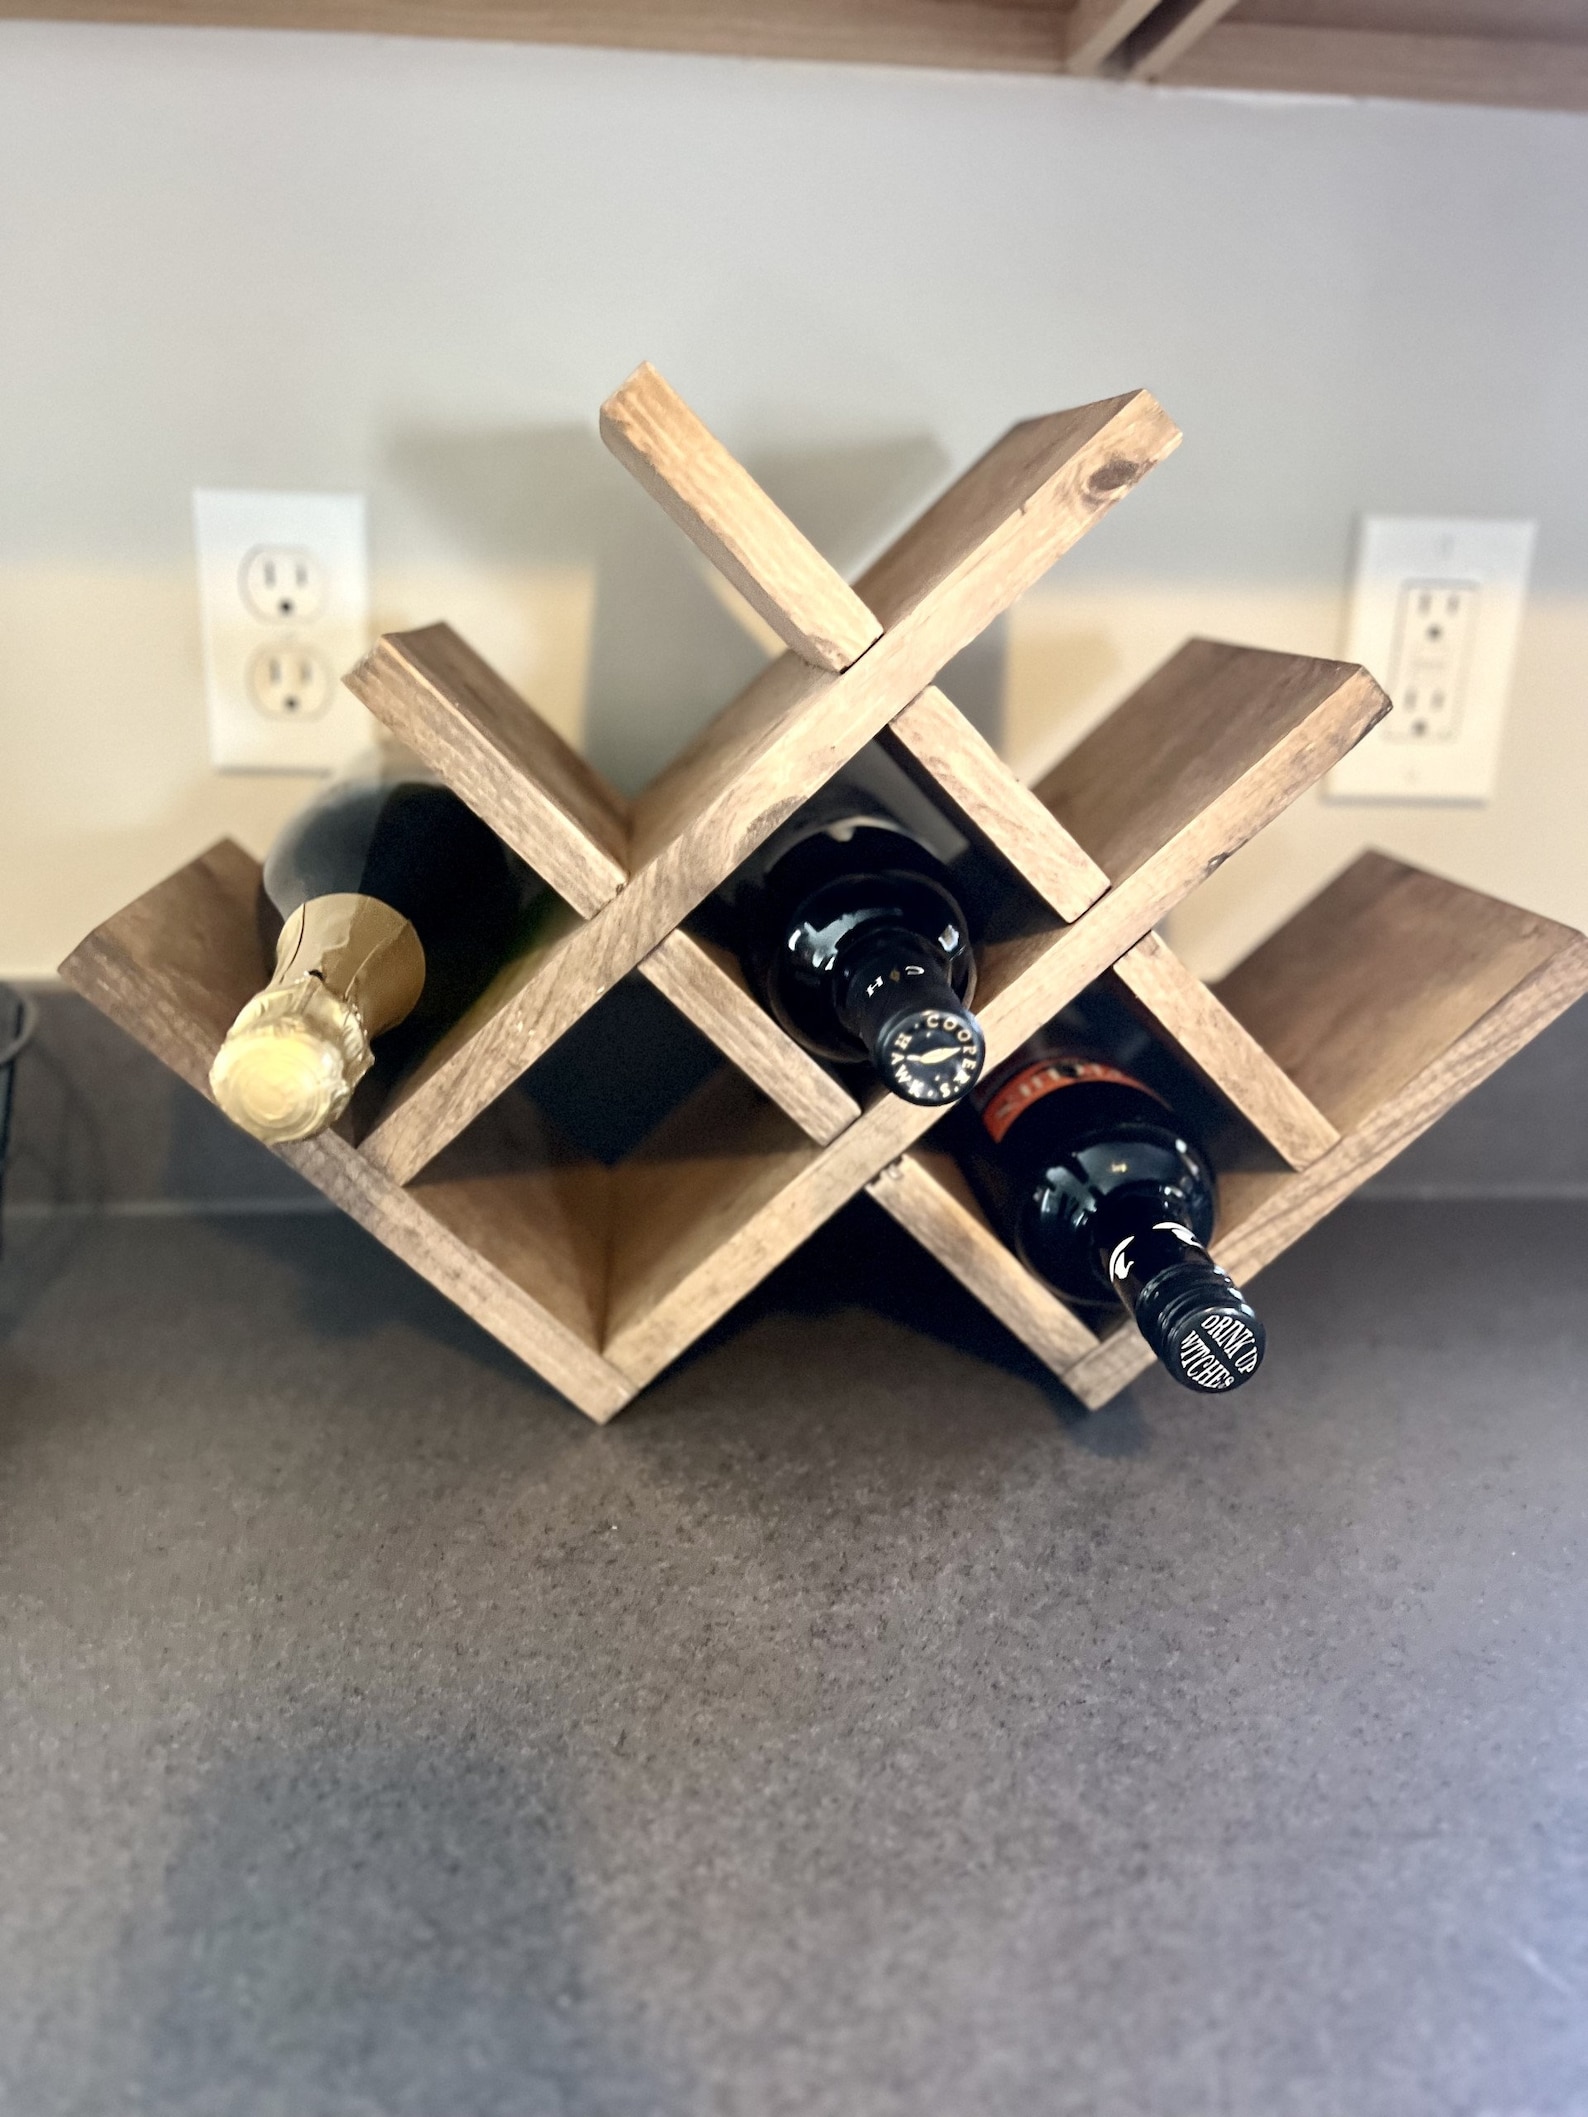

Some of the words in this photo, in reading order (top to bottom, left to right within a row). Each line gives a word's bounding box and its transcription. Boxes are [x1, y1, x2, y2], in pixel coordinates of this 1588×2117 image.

[891, 1032, 925, 1098] HAWK
[1180, 1330, 1235, 1390] WITCHES
[1201, 1314, 1255, 1360] DRINK
[1235, 1346, 1258, 1374] UP
